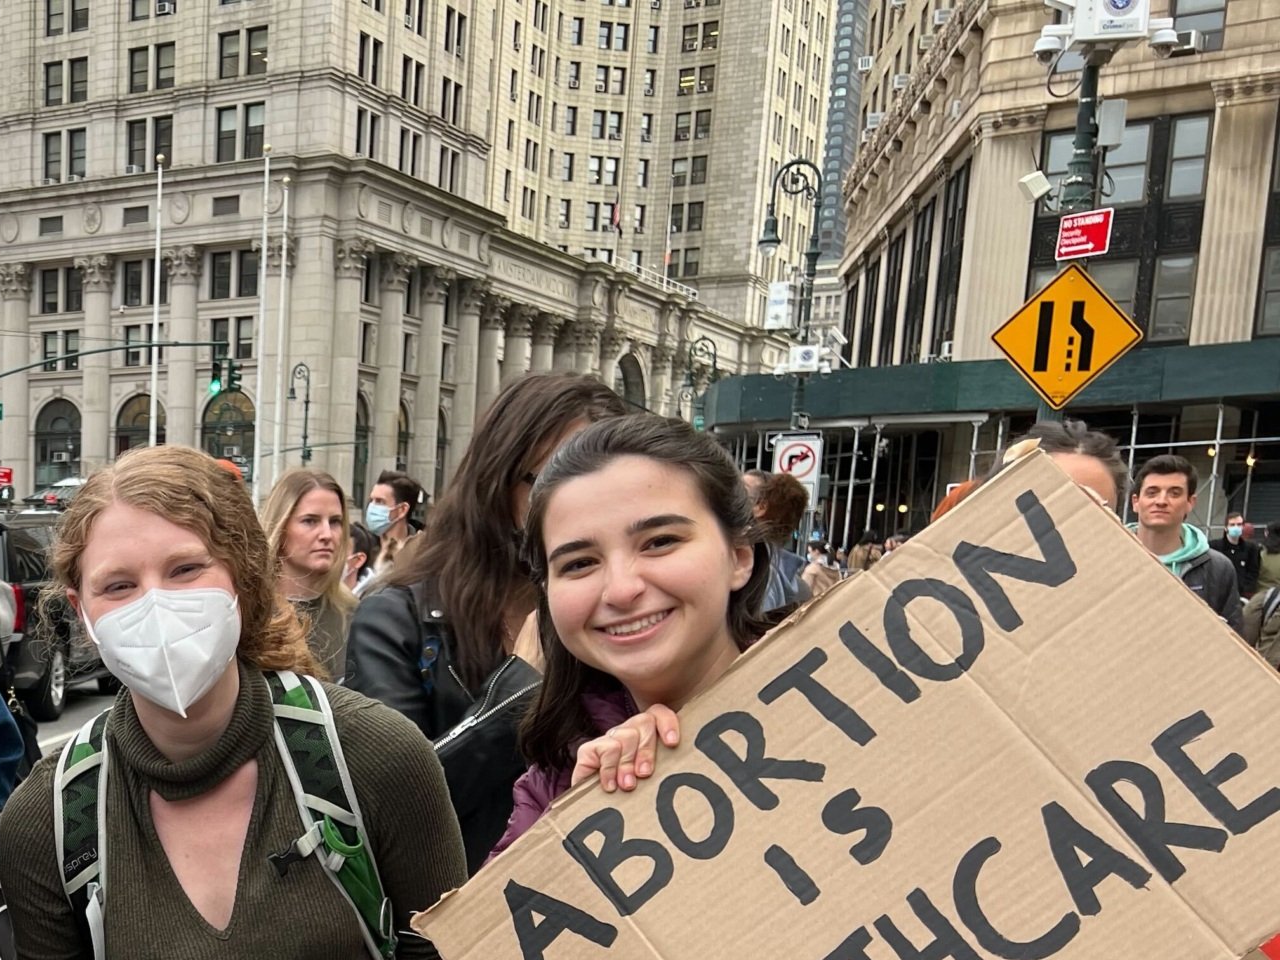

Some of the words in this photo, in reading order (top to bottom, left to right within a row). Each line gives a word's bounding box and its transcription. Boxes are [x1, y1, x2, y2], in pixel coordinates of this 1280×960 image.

[1063, 219, 1072, 228] NO
[764, 787, 893, 905] IS
[64, 848, 97, 873] sprey
